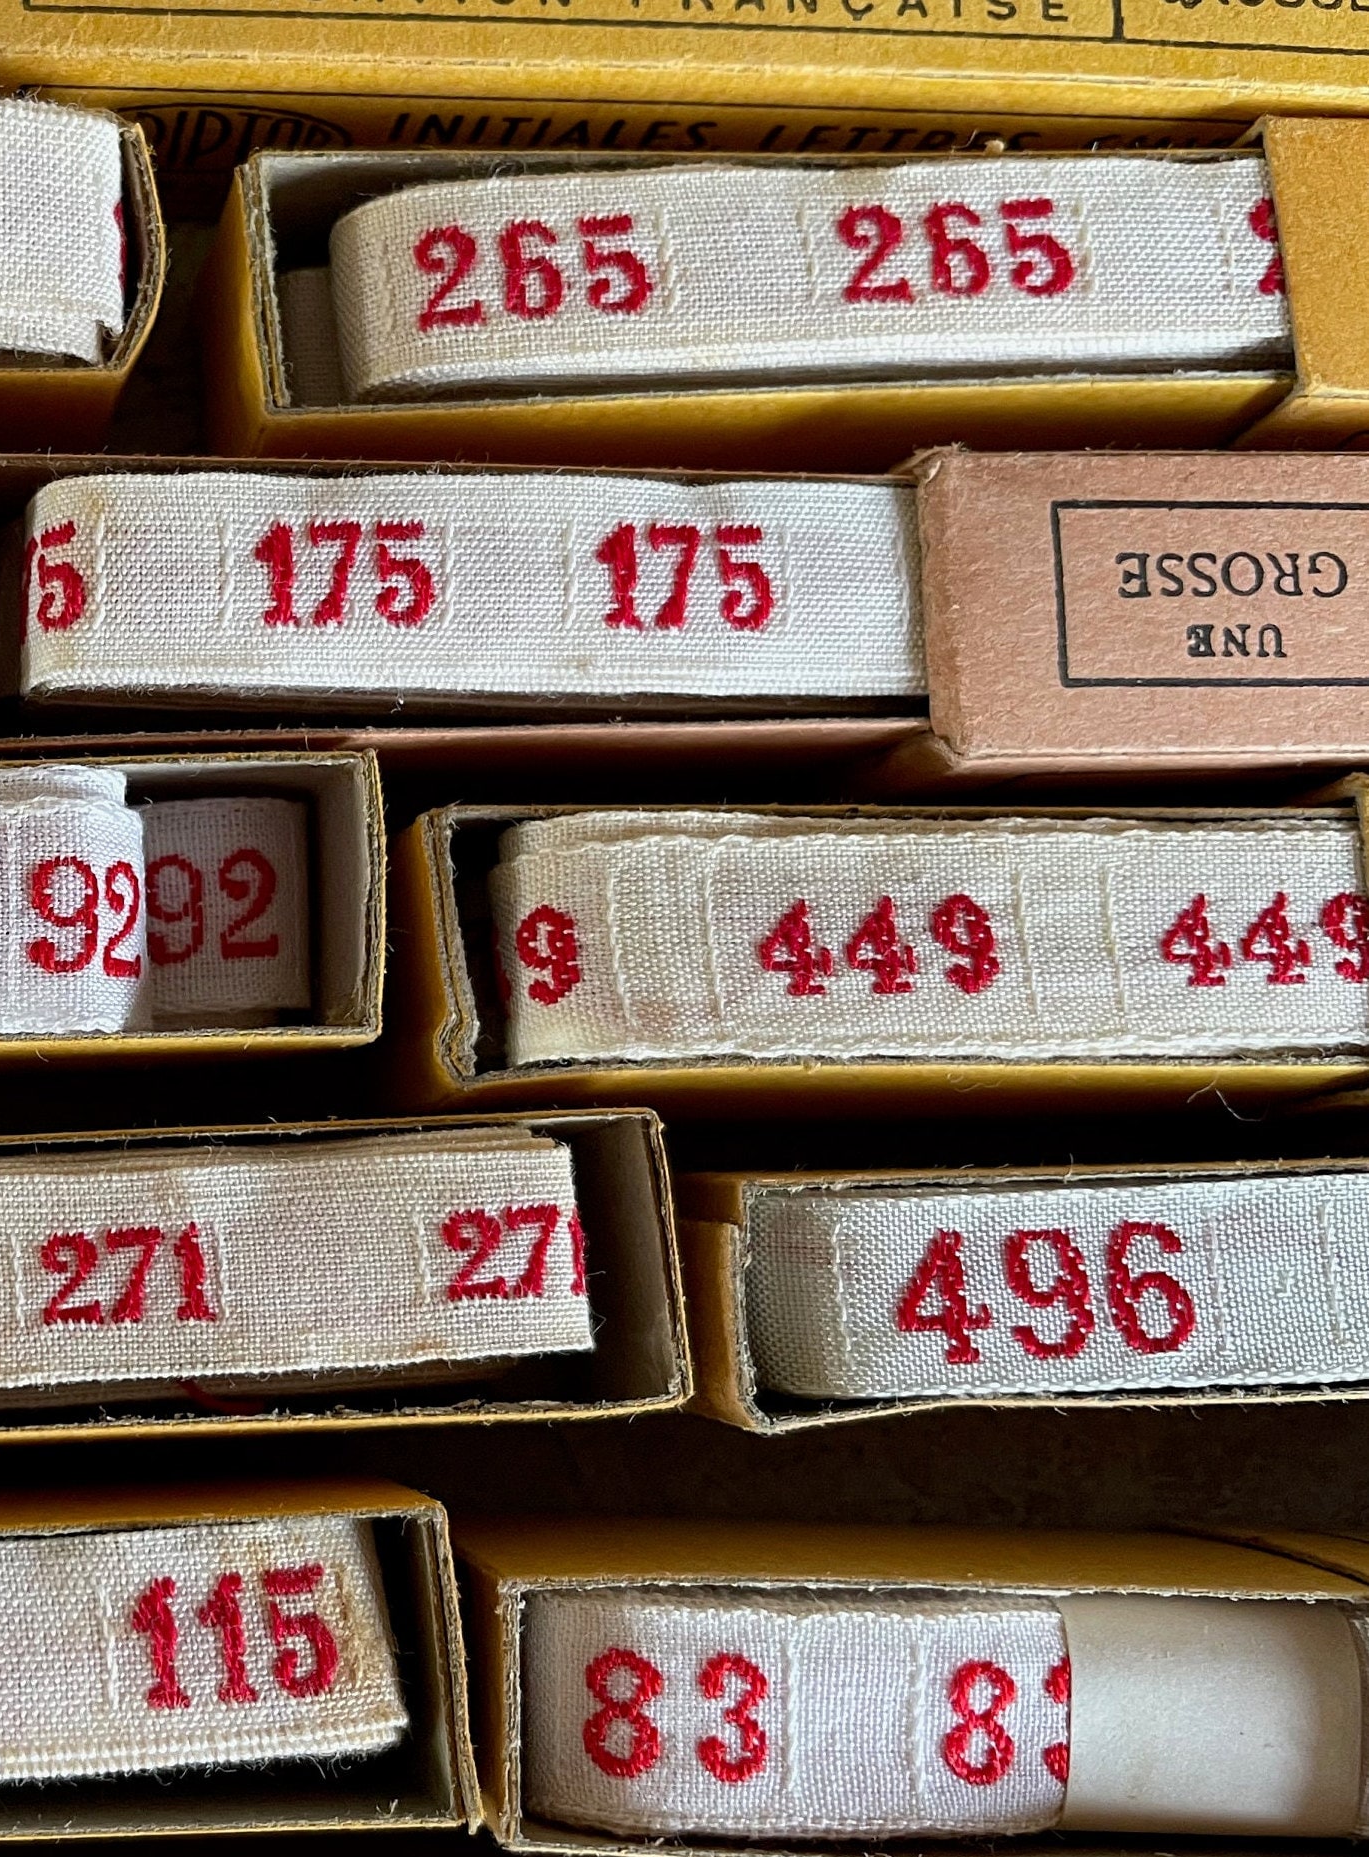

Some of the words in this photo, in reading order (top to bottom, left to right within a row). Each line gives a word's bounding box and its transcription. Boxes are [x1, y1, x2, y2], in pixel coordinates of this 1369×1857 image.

[412, 213, 653, 332] 265
[837, 197, 1075, 303] 265
[19, 520, 87, 645] 5
[253, 520, 435, 630] 175
[596, 522, 775, 632] 175
[1115, 551, 1349, 599] GROSSE
[1186, 623, 1288, 659] UNE
[26, 855, 141, 979] 92
[145, 848, 279, 968] 92
[757, 893, 1000, 997] 449
[1160, 891, 1366, 986] 449
[41, 1221, 216, 1326] 271
[895, 1218, 1197, 1365] 496
[131, 1564, 339, 1710] 115
[582, 1646, 769, 1784] 83
